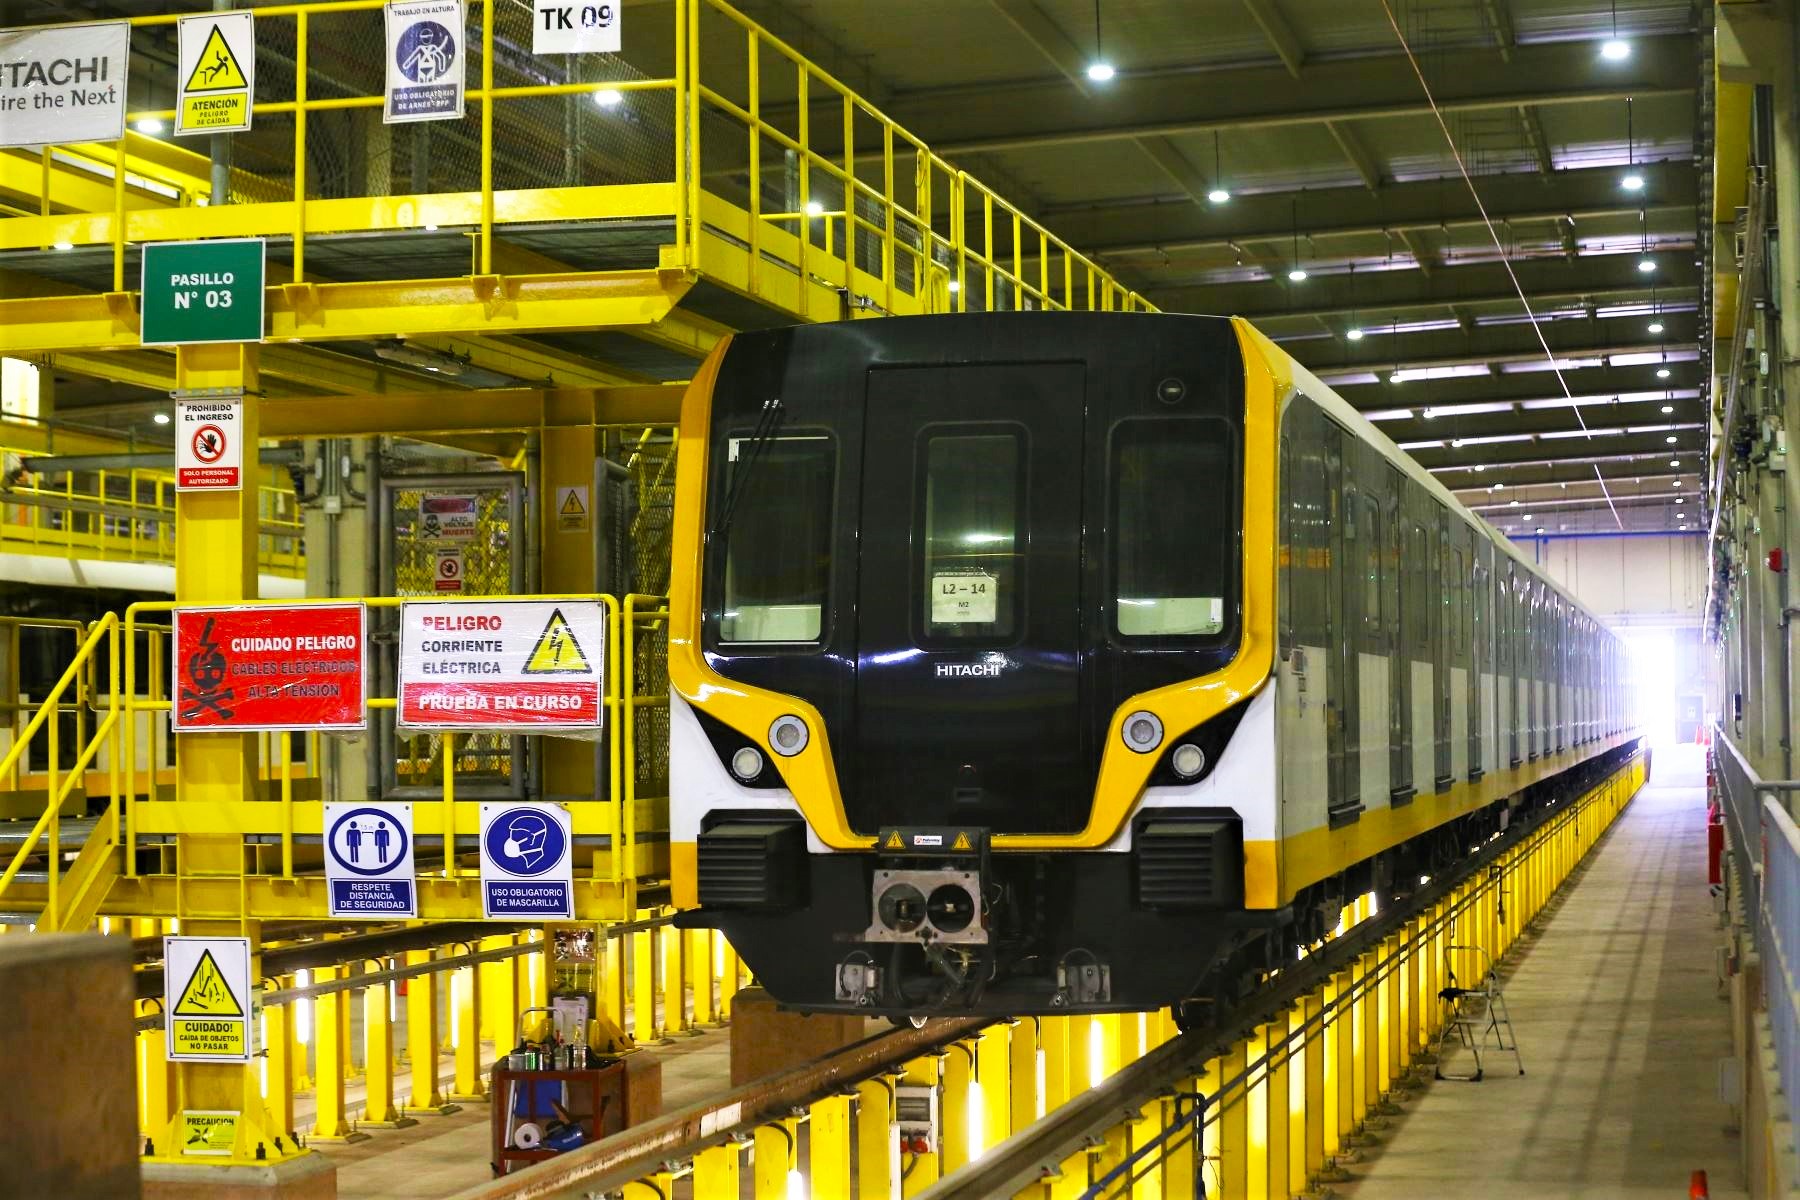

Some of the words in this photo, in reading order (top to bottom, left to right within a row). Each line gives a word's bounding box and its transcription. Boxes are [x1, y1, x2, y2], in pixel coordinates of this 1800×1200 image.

[540, 7, 573, 30] TK
[581, 5, 613, 28] 09
[33, 91, 64, 109] the
[71, 85, 116, 106] Next
[200, 110, 229, 118] PELIGRO
[171, 272, 234, 286] PASILLO
[205, 290, 233, 308] 03
[187, 404, 232, 412] PROHIBIDO
[197, 413, 234, 421] INGRESO
[201, 469, 234, 477] PERSONAL
[943, 584, 956, 595] L2
[971, 584, 986, 594] 14
[422, 616, 502, 631] PELIGRO
[231, 637, 292, 652] CUIDADO
[296, 635, 356, 650] PELIGRO
[422, 640, 503, 653] CORRIENTE
[231, 662, 278, 675] CABLES
[422, 659, 502, 675] ELÉCTRICA
[936, 665, 1000, 676] HITACHI
[248, 685, 279, 698] ALTA
[419, 694, 489, 710] PRUEBA
[494, 695, 517, 710] EN
[521, 694, 582, 710] CURSO
[351, 883, 391, 891] RESPETE
[491, 888, 508, 896] USO
[510, 888, 563, 896] OBLIGATORIO
[349, 892, 395, 900] DISTANCIA
[354, 901, 405, 909] SEGURIDAD
[509, 899, 560, 907] MASCARILLA
[185, 1022, 233, 1032] CUIDADO!
[190, 1042, 201, 1050] NO
